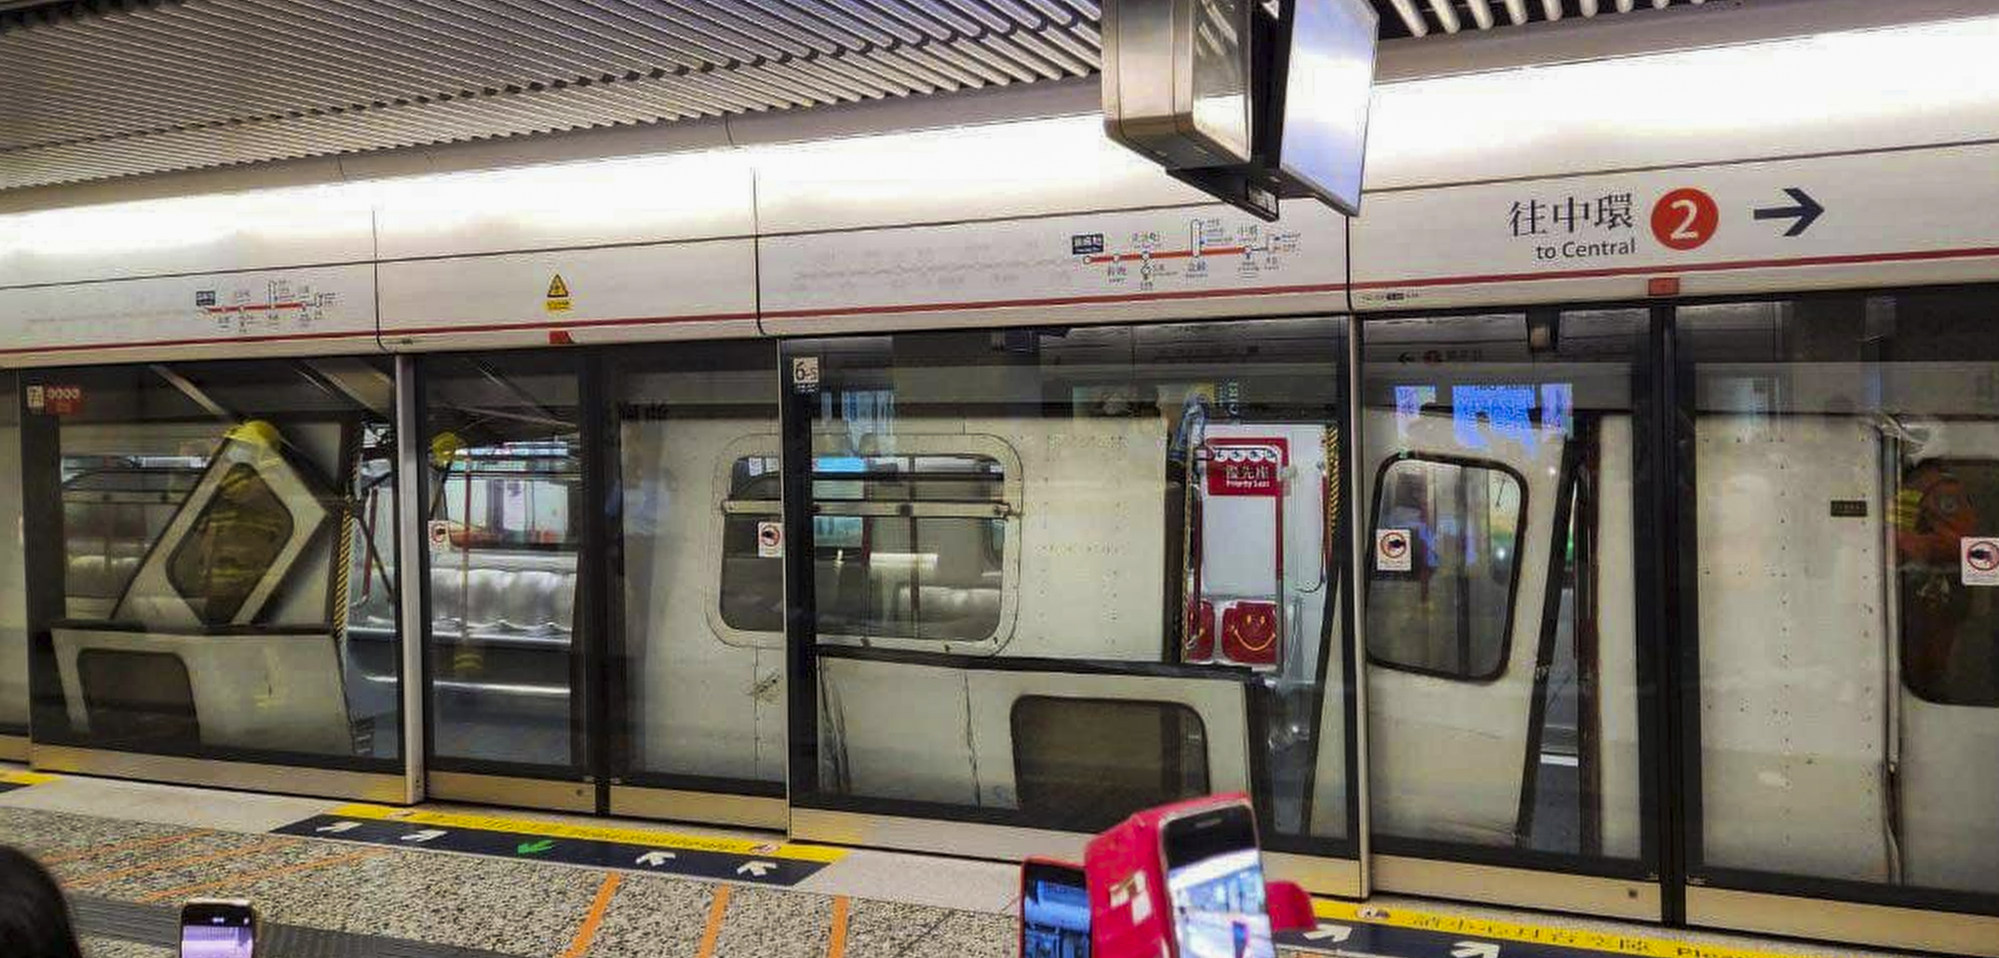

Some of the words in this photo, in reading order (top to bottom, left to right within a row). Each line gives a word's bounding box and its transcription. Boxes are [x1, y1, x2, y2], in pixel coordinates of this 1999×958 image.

[1509, 193, 1634, 237] 往中環
[1670, 199, 1700, 242] 2
[1537, 246, 1557, 260] to
[1562, 238, 1636, 258] Central
